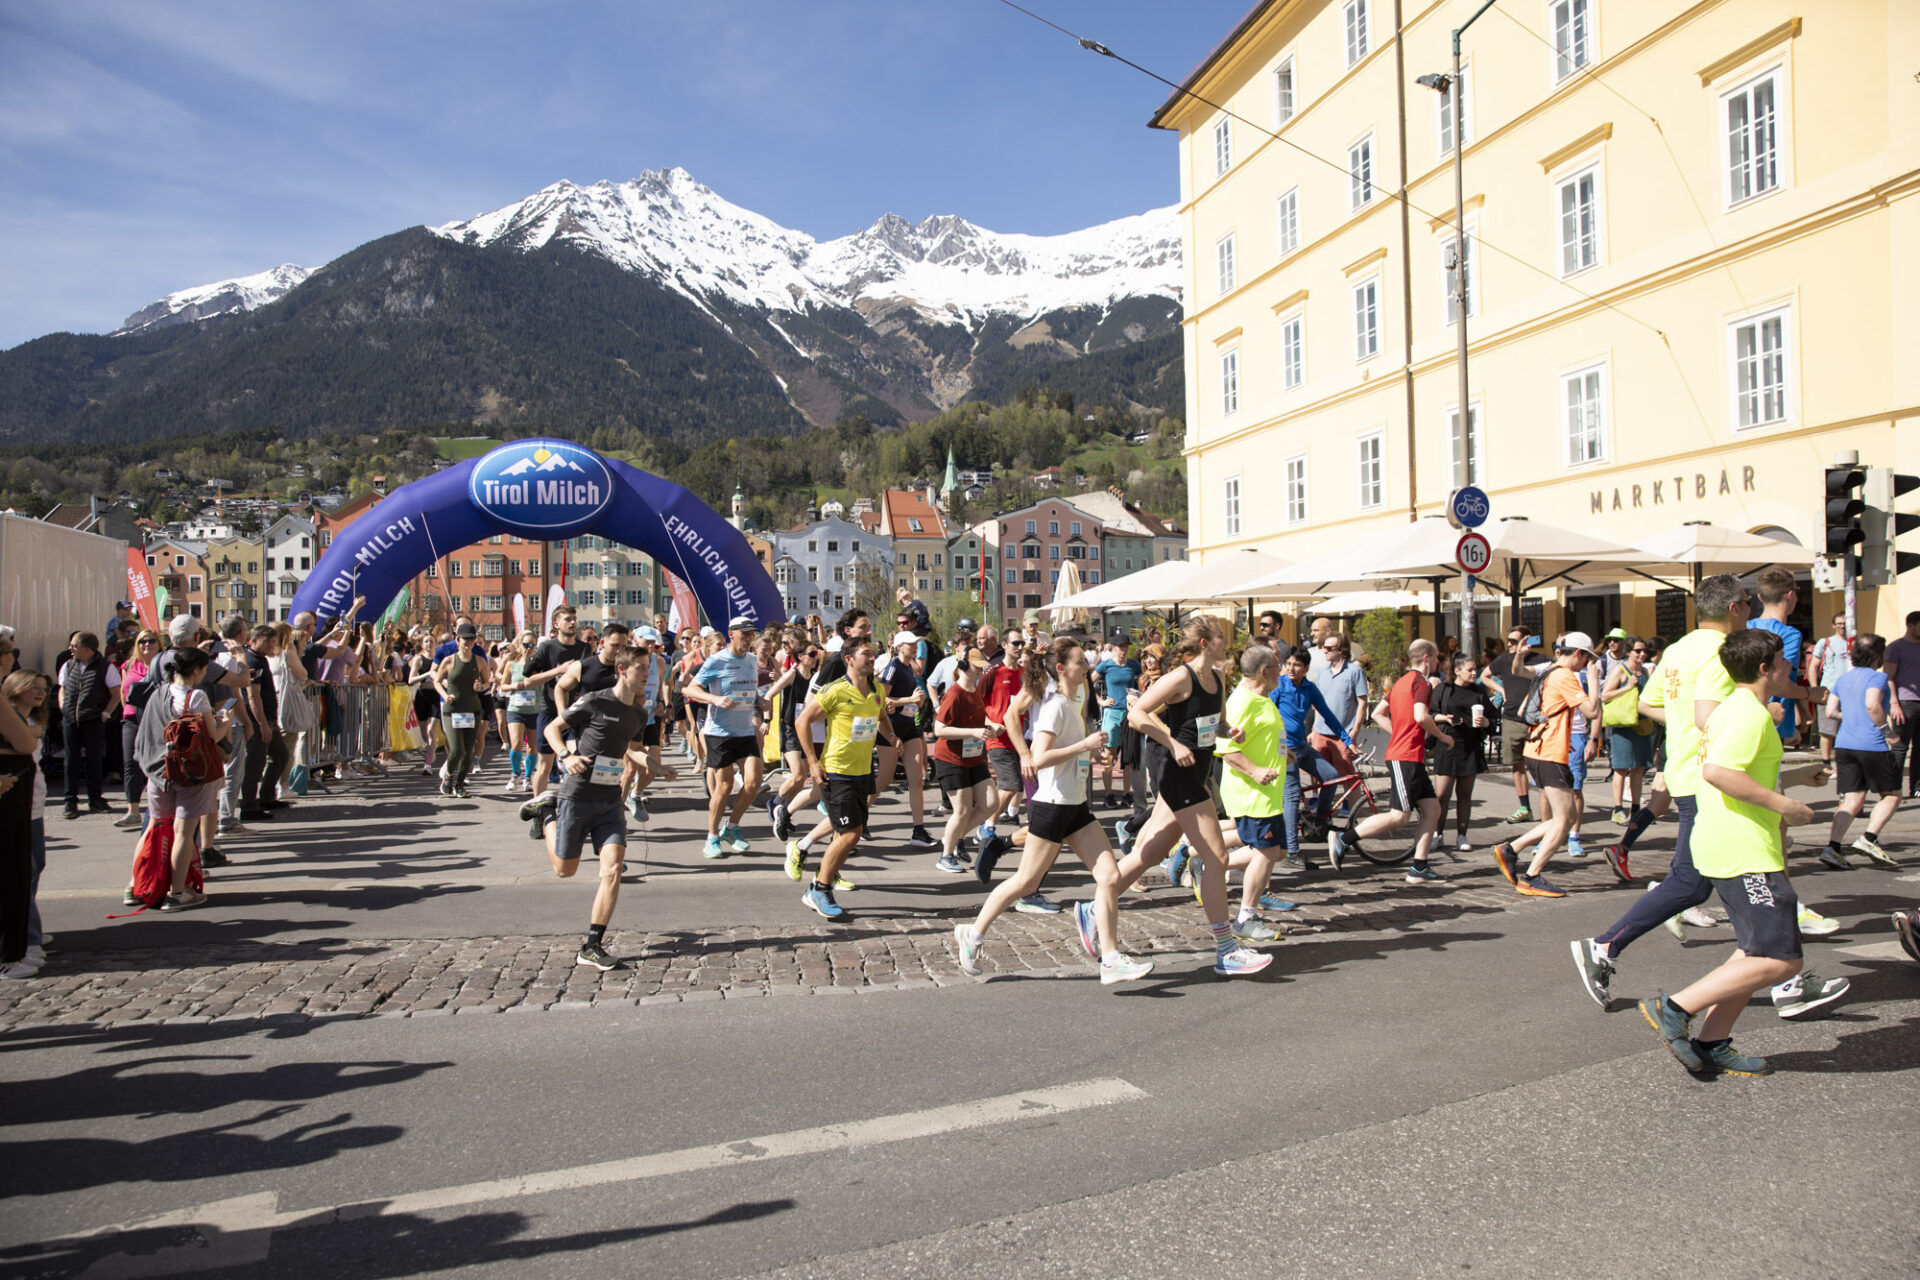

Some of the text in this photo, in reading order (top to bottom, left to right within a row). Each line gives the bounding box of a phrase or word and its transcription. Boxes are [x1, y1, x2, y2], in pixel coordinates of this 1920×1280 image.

[483, 480, 600, 505] Tirol Milch
[1590, 465, 1756, 513] MARKTBAR
[316, 570, 361, 618] TIROL
[355, 516, 416, 566] MILCH
[665, 514, 729, 576] EHRLICH
[839, 816, 849, 826] 12
